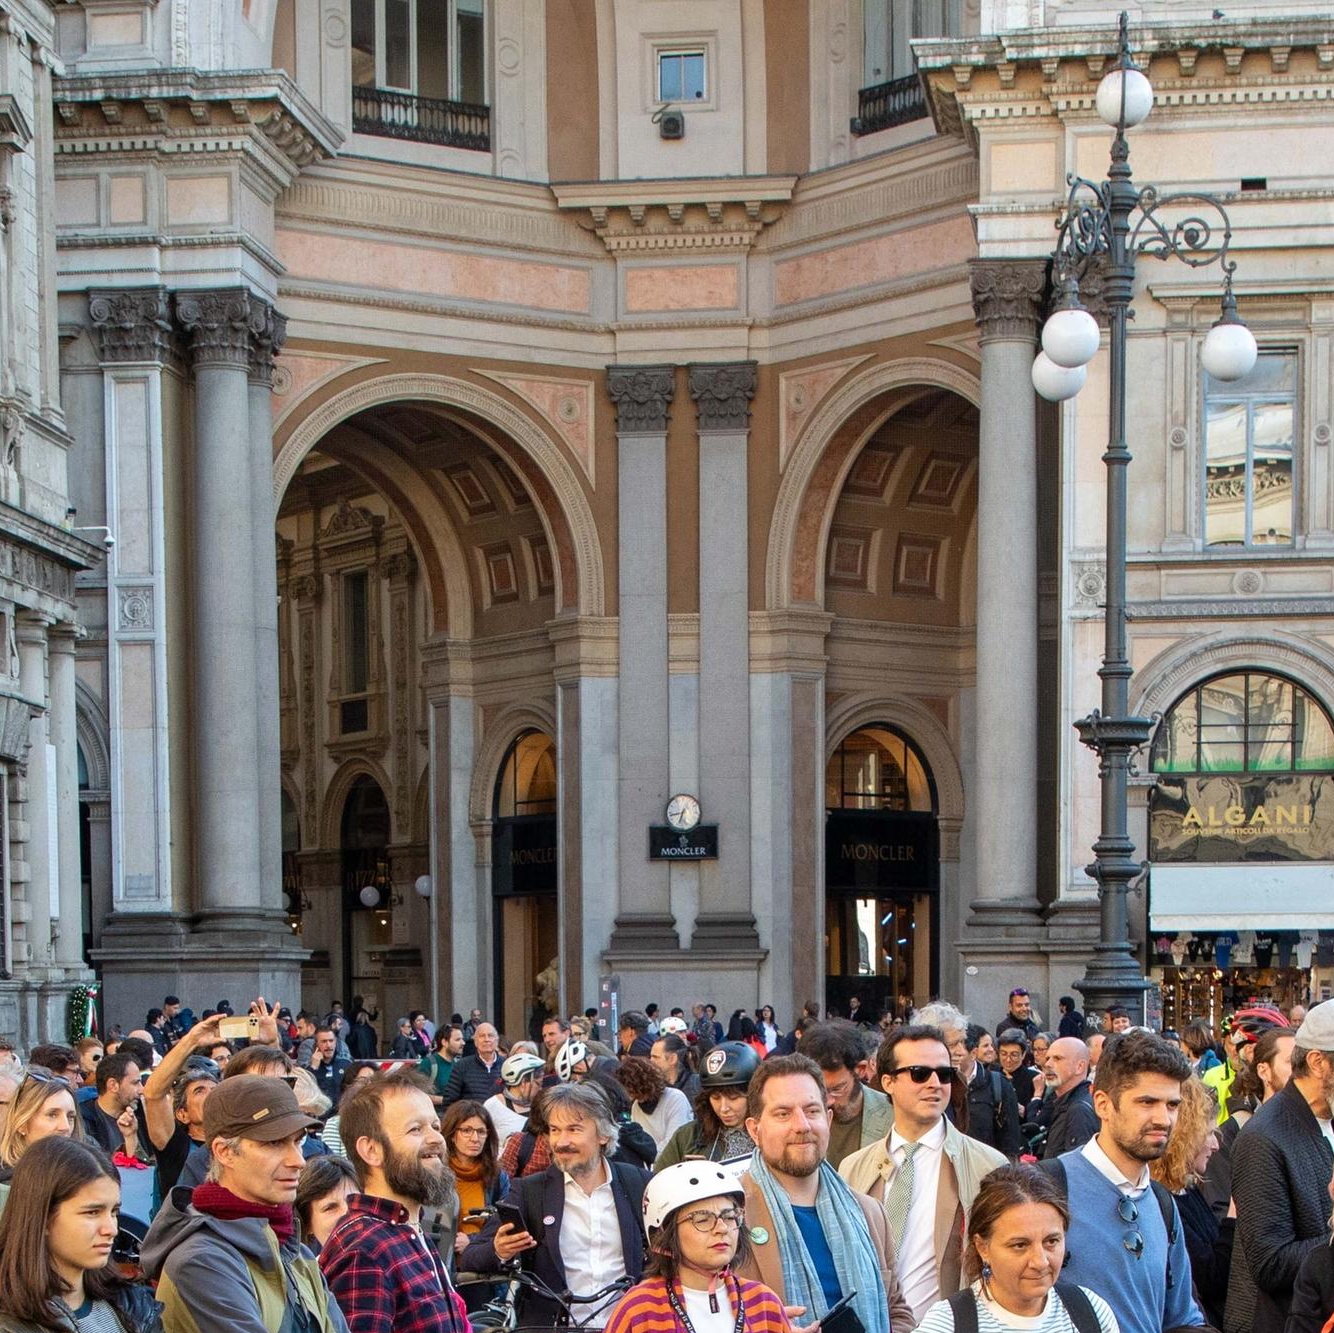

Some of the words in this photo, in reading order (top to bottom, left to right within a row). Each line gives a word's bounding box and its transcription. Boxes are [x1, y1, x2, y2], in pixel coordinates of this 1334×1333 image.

[1182, 804, 1310, 826] ALGANI
[660, 847, 706, 857] MONCLER
[841, 843, 915, 861] MONCLER
